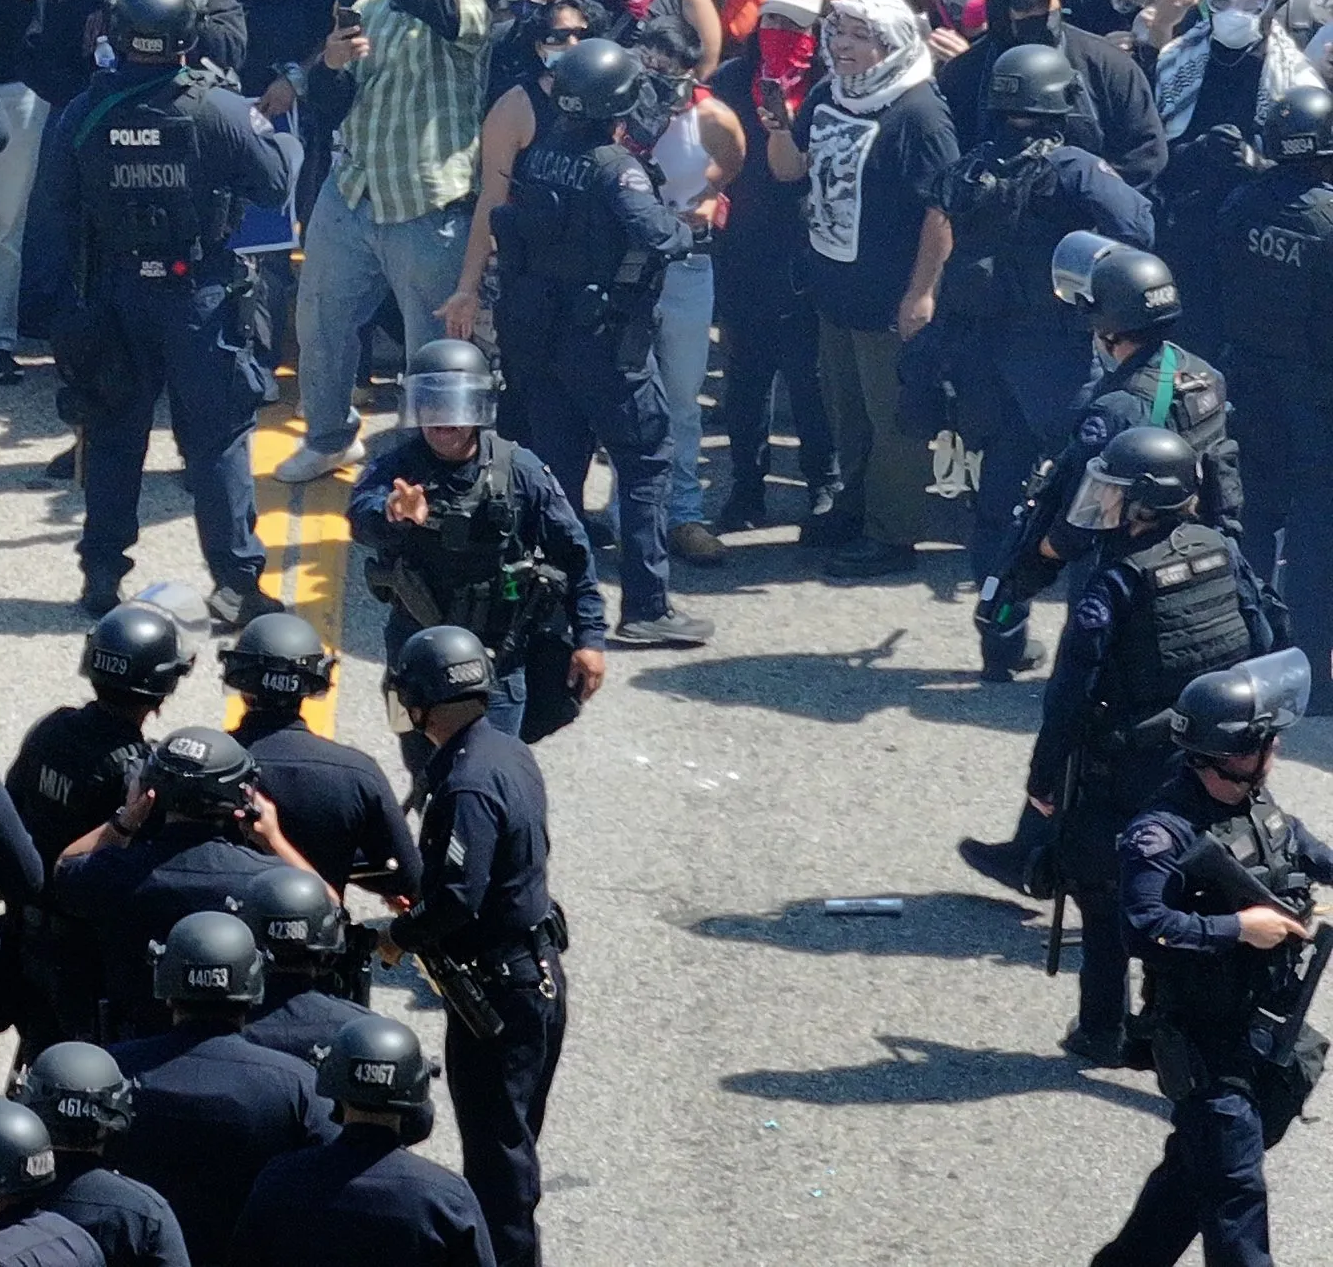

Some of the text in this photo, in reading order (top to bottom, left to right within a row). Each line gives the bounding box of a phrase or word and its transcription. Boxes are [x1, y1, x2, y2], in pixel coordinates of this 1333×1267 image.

[110, 128, 161, 146] POLICE
[109, 162, 187, 189] JOHNSON
[1248, 228, 1302, 268] SOSA
